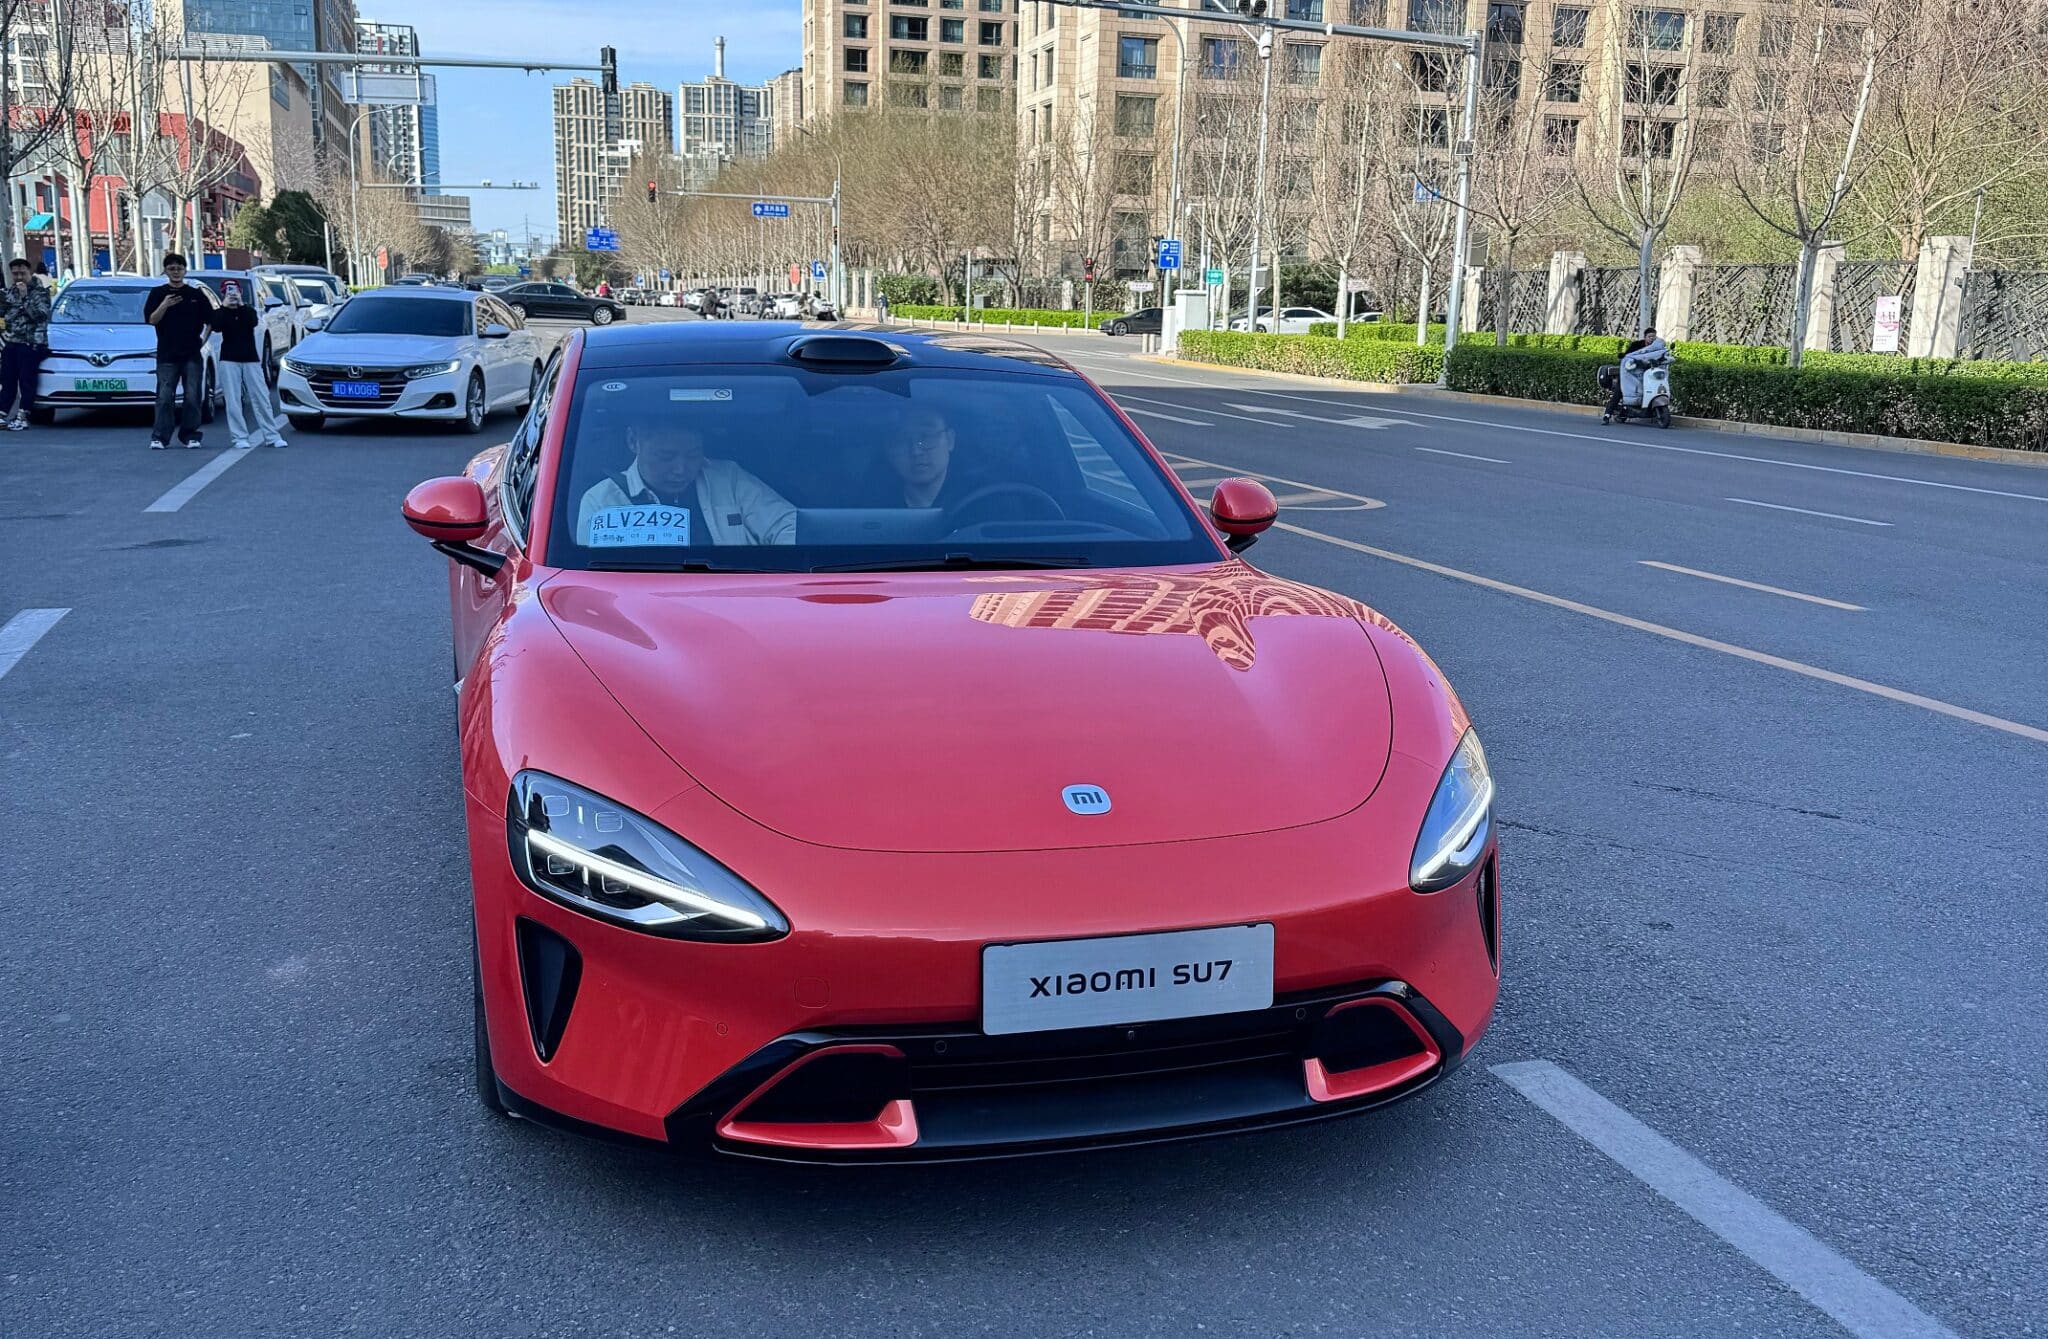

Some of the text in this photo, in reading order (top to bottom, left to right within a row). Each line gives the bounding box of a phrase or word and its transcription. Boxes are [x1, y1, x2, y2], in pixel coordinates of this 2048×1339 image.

[1161, 243, 1169, 252] P
[593, 511, 686, 530] 京LV2492
[1172, 960, 1233, 985] SU7
